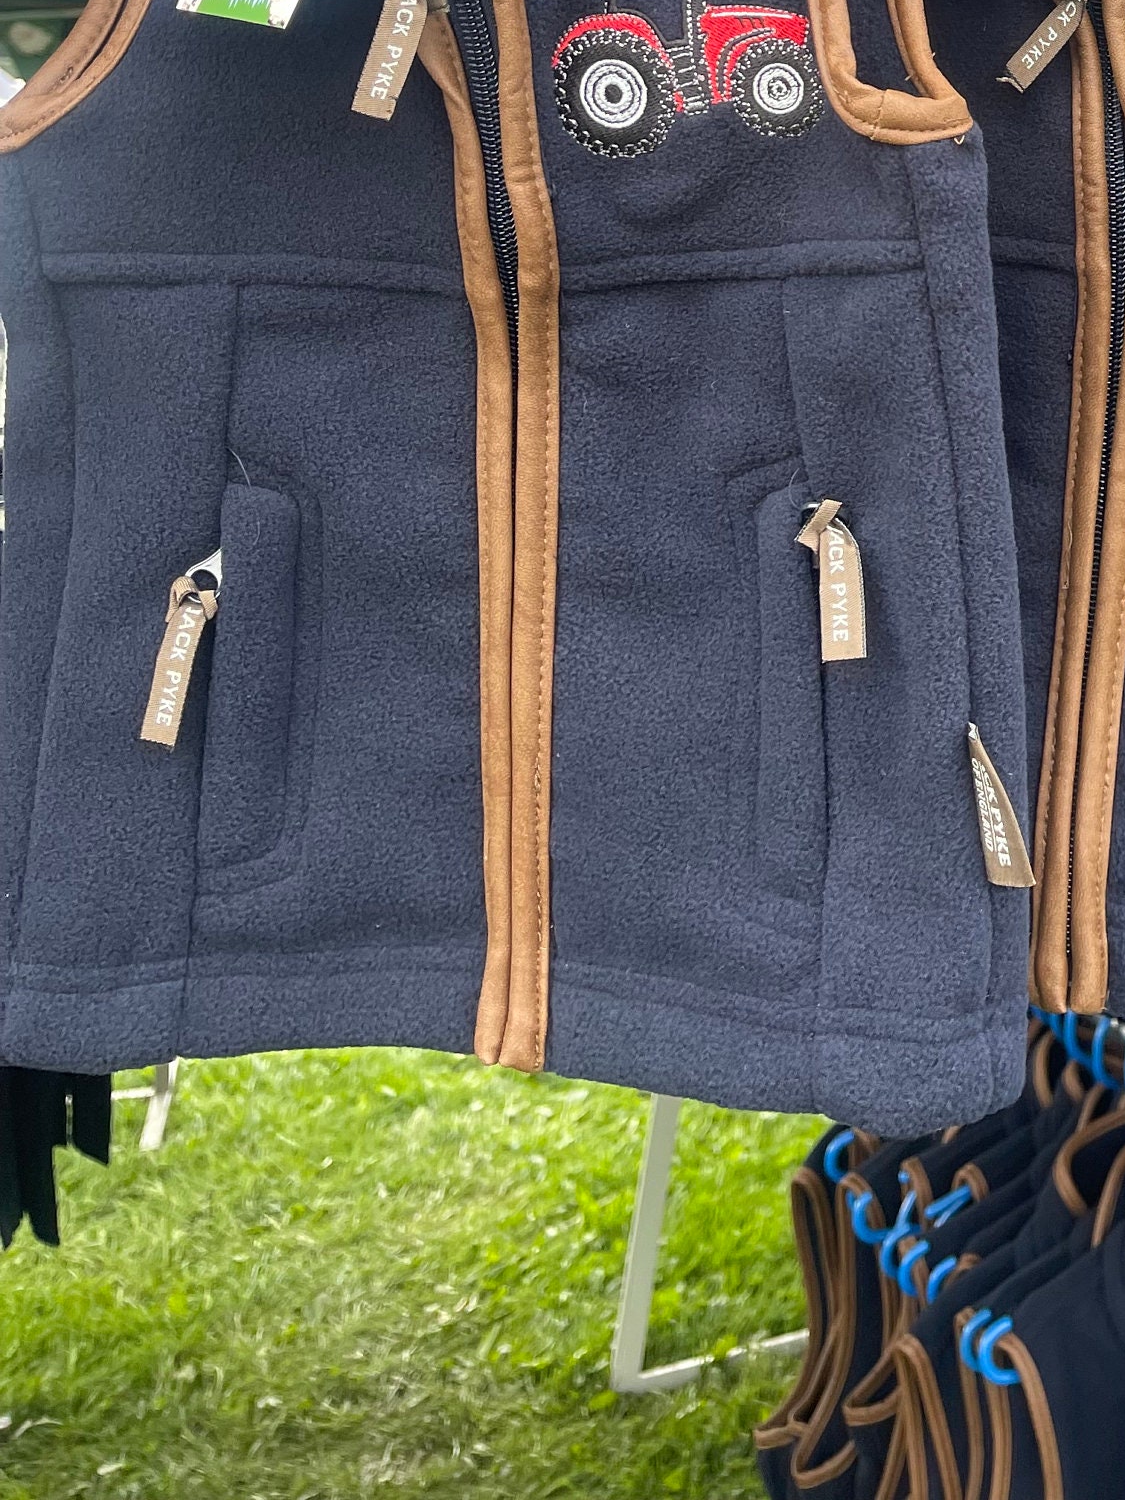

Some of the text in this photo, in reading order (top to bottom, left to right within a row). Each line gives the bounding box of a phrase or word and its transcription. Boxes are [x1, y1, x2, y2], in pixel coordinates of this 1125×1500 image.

[370, 44, 403, 100] PYKE
[1022, 26, 1059, 70] PYKE
[830, 583, 849, 642] PYKE
[156, 606, 201, 727] JACK PYKE
[989, 806, 1011, 867] PYKE
